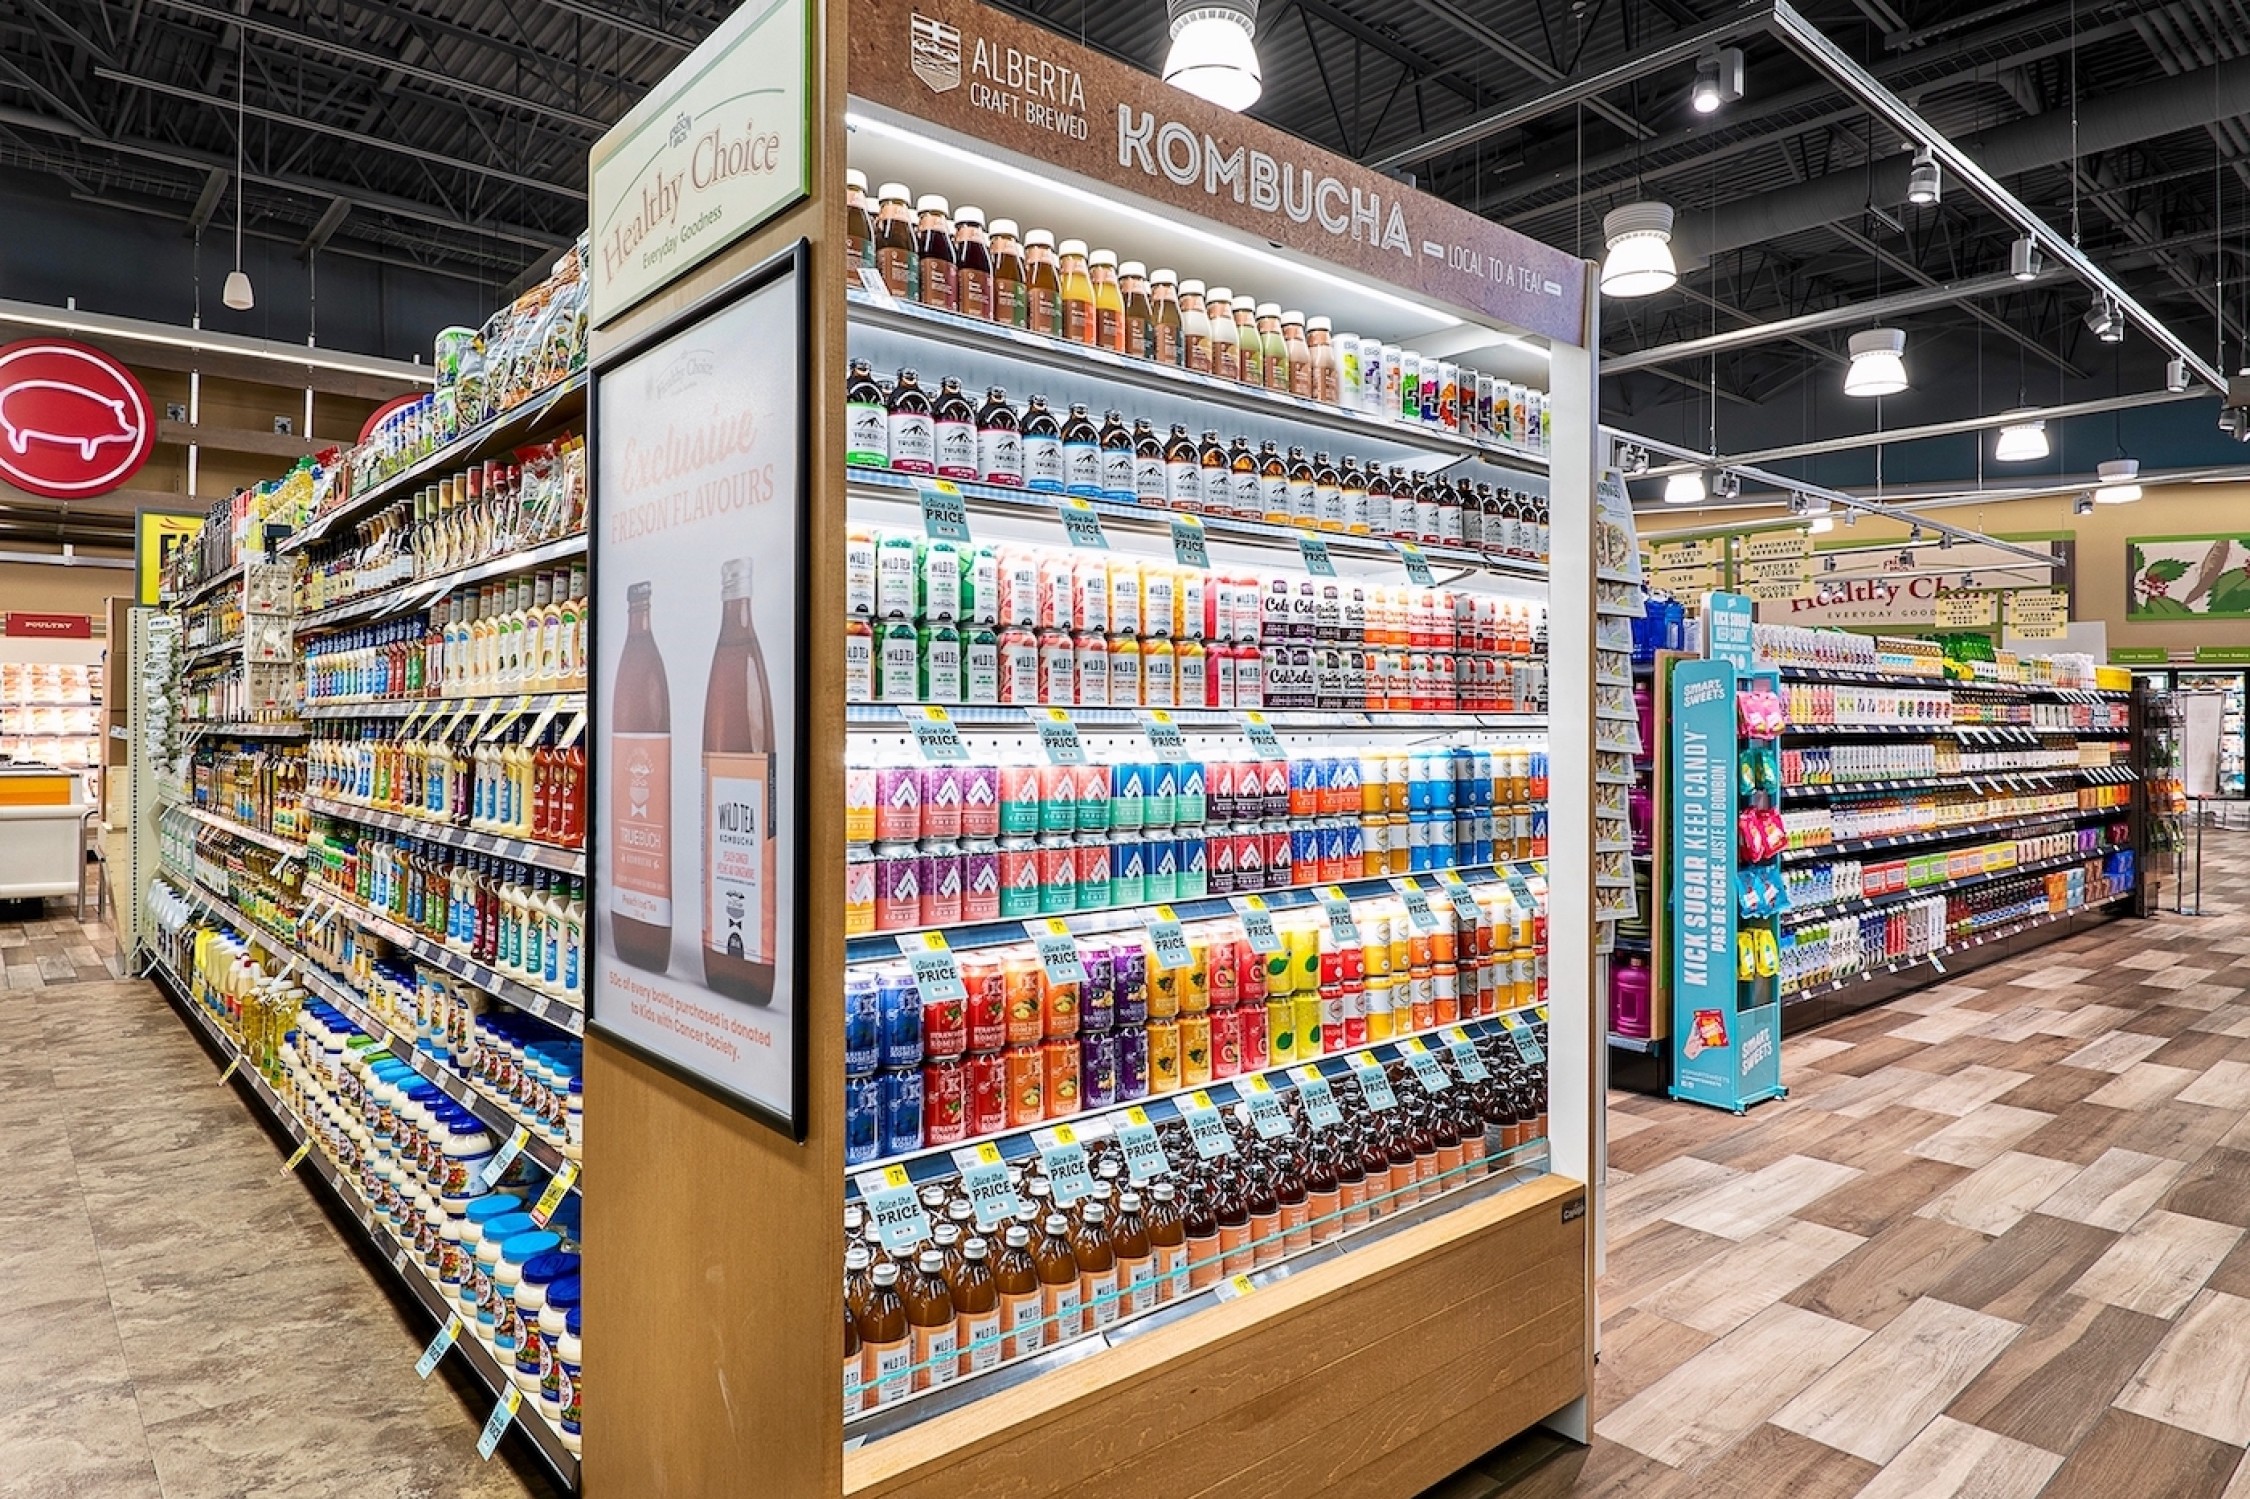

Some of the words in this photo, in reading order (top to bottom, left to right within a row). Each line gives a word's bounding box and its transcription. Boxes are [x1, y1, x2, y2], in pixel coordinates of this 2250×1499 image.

[972, 36, 1087, 112] ALBERTA
[970, 82, 1020, 119] CRAFT
[1025, 102, 1089, 141] BREWED
[1118, 102, 1412, 258] KOMBUCHA
[602, 168, 685, 287] Healthy
[691, 120, 780, 191] Choice
[642, 228, 680, 271] Everyday
[680, 203, 723, 245] Goodness
[1447, 244, 1484, 278] LOCAL
[1488, 258, 1503, 283] TO
[1506, 263, 1515, 288] A
[1518, 265, 1542, 295] TEA!
[621, 402, 758, 496] Exclusive
[611, 497, 668, 545] FRESON
[673, 463, 774, 526] FLAVOURS
[926, 508, 965, 525] PRICE
[1066, 521, 1101, 535] PRICE
[1175, 539, 1204, 552] PRICE
[1747, 540, 1806, 551] CARBONATED
[1750, 547, 1802, 557] BEVERAGES
[1661, 550, 1703, 560] PROTEIN
[1752, 562, 1801, 572] NATURAL
[1759, 569, 1795, 578] JUICES
[1752, 584, 1800, 594] COCONUT
[1827, 610, 1892, 619] EVERYDAY
[1902, 609, 1936, 618] GOOD
[25, 621, 73, 630] POULTRY
[1684, 679, 1723, 694] SMART
[1684, 688, 1725, 708] SWEETS
[918, 735, 960, 746] PRICE
[1045, 737, 1079, 748] PRICE
[1151, 736, 1183, 748] PRICE
[1249, 735, 1279, 746] PRICE
[718, 802, 739, 832] WILD
[740, 804, 755, 834] TEA
[1684, 803, 1708, 850] KEEP
[1710, 811, 1727, 827] DU
[719, 834, 755, 847] KOMBUCHA
[1710, 828, 1727, 863] JUSTE
[1684, 855, 1708, 929] SUGAR
[1710, 864, 1727, 905] SUCRE
[1710, 907, 1727, 925] DE
[1247, 925, 1274, 938] PRICE
[1710, 926, 1727, 954] PAS
[1155, 937, 1185, 951] PRICE
[1044, 951, 1078, 966] PRICE
[1684, 933, 1708, 986] KICK
[918, 968, 957, 985] PRICE
[623, 976, 631, 987] of
[631, 982, 650, 1002] every
[652, 986, 674, 1009] bottle
[675, 997, 721, 1028] purchased
[721, 1012, 729, 1031] is
[730, 1018, 771, 1047] donated
[631, 1001, 639, 1015] to
[639, 1005, 655, 1023] Kids
[656, 1011, 674, 1031] with
[674, 1019, 705, 1042] Cancer
[705, 1031, 740, 1062] Society.
[1742, 1028, 1770, 1059] SMART
[1742, 1040, 1773, 1076] SWEETS
[1253, 1105, 1281, 1121] PRICE
[1194, 1122, 1224, 1140] PRICE
[1128, 1140, 1159, 1160] PRICE
[1050, 1161, 1085, 1181] PRICE
[971, 1180, 1011, 1201] PRICE
[877, 1204, 920, 1227] PRICE
